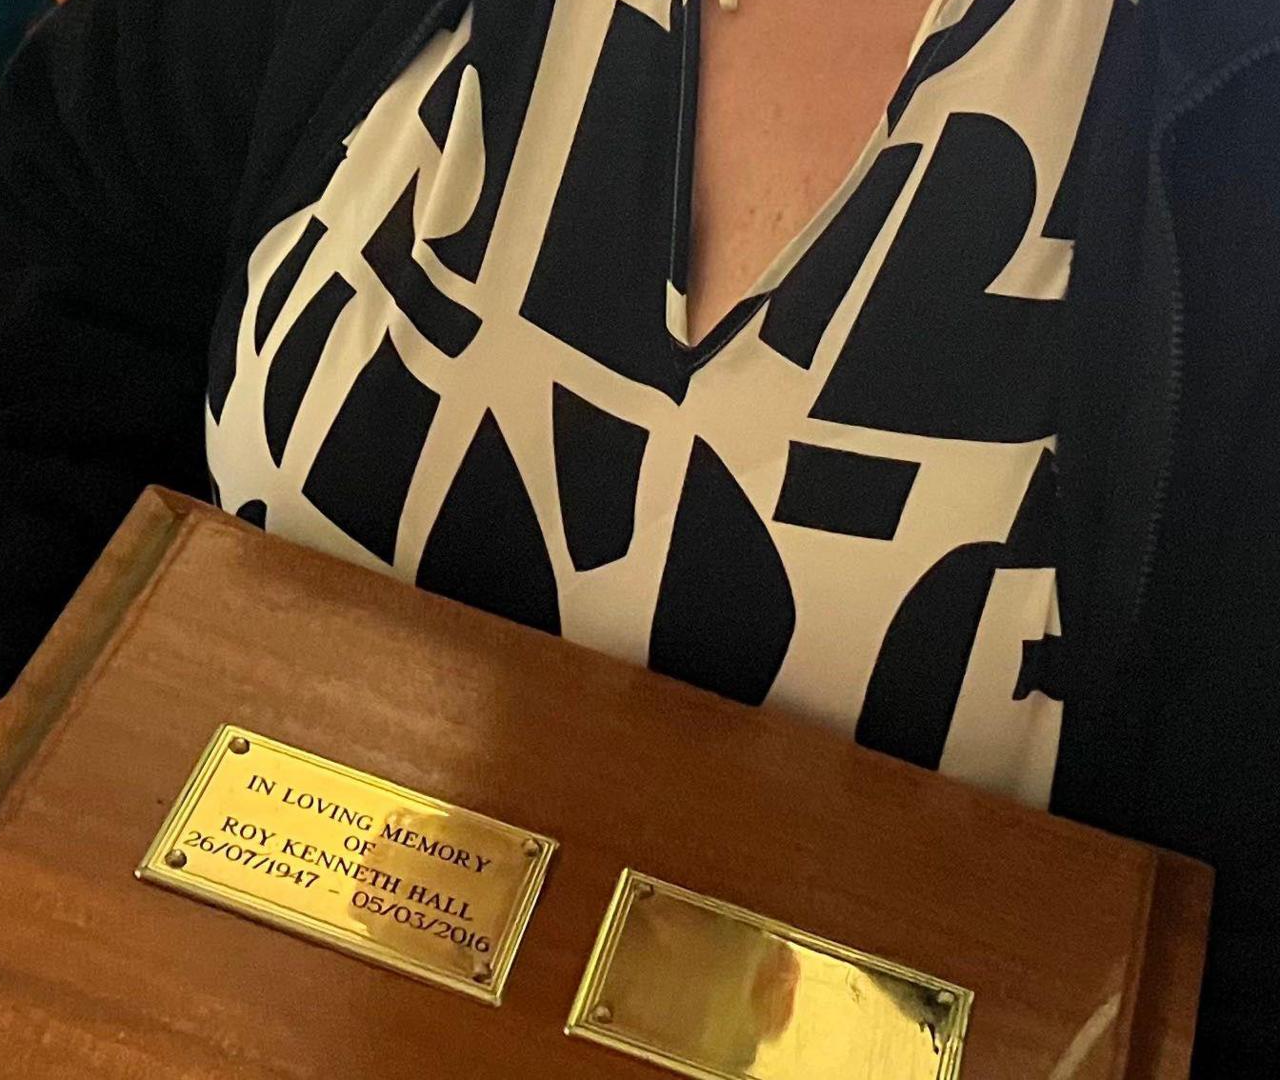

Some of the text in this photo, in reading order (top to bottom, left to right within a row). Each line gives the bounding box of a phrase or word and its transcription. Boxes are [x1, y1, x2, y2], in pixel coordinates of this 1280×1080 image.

[220, 815, 474, 921] ROY KENNETH HALL
[246, 774, 494, 874] IN LOVING MEMORY
[343, 835, 377, 857] OF
[183, 830, 321, 889] 26/07/1947
[351, 890, 491, 954] 05/03/2016
